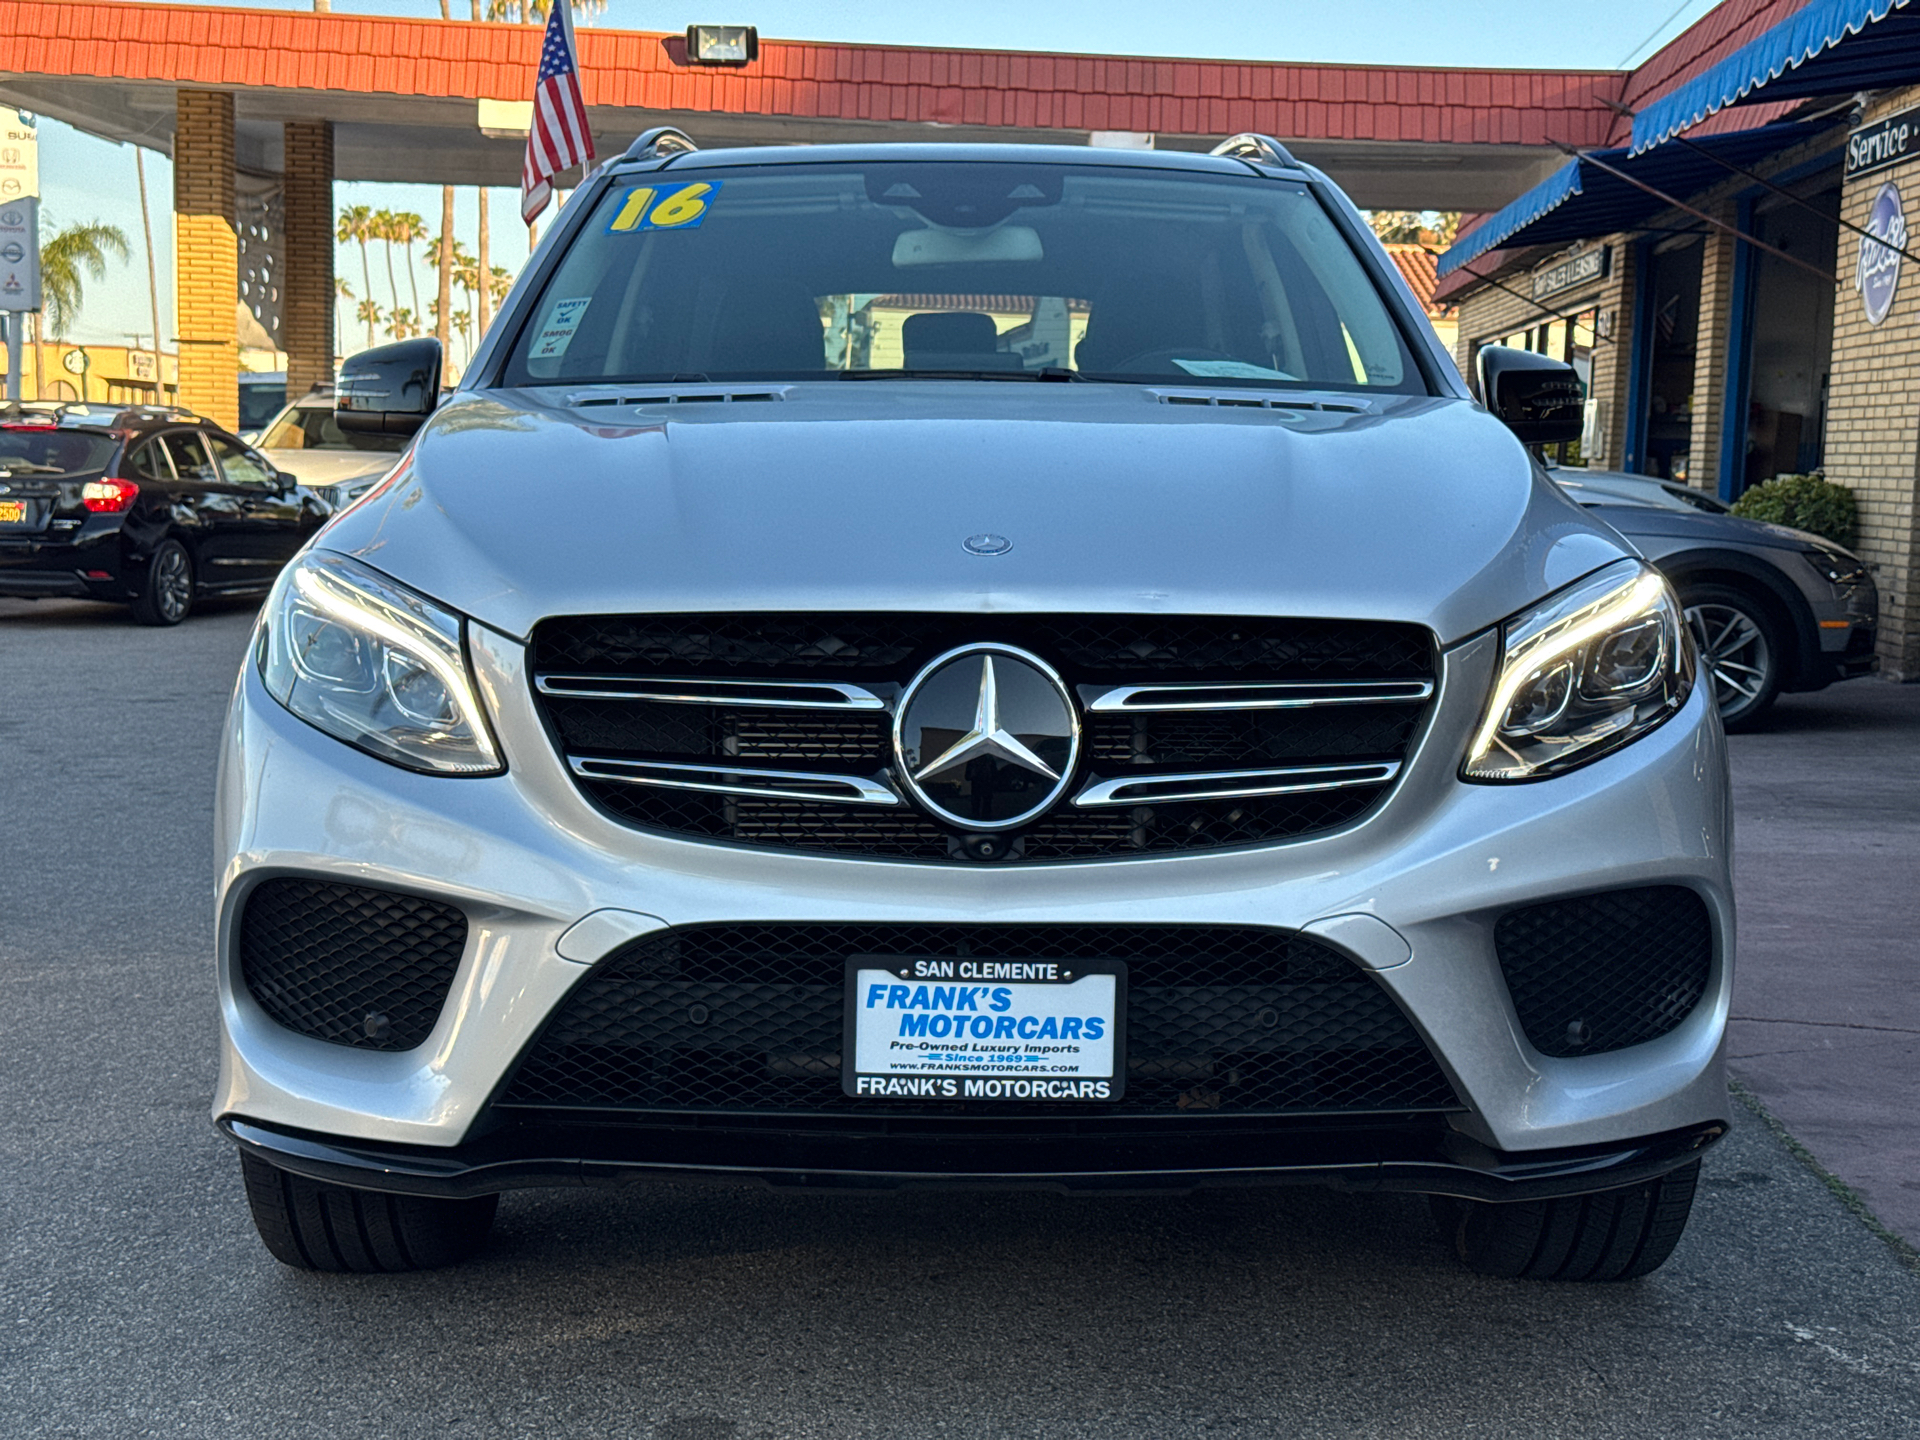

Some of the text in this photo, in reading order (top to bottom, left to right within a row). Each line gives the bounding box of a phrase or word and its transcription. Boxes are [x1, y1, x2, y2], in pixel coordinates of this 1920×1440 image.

[1848, 120, 1908, 171] Service
[610, 183, 713, 231] 16
[556, 300, 588, 309] SAFETY
[556, 317, 572, 325] OK
[542, 329, 573, 338] SMOG
[914, 961, 1058, 980] SAN CLEMENTE
[866, 984, 1013, 1013] FRANK'S
[899, 1014, 1106, 1040] MOTORCARS
[890, 1041, 1080, 1054] Pre-Owned Luxury Imports
[945, 1053, 1023, 1063] Since 1969
[890, 1062, 1079, 1073] www.FRANKSMOTORCARS.COM
[857, 1077, 1110, 1098] FRANK'S MOTORCARS
